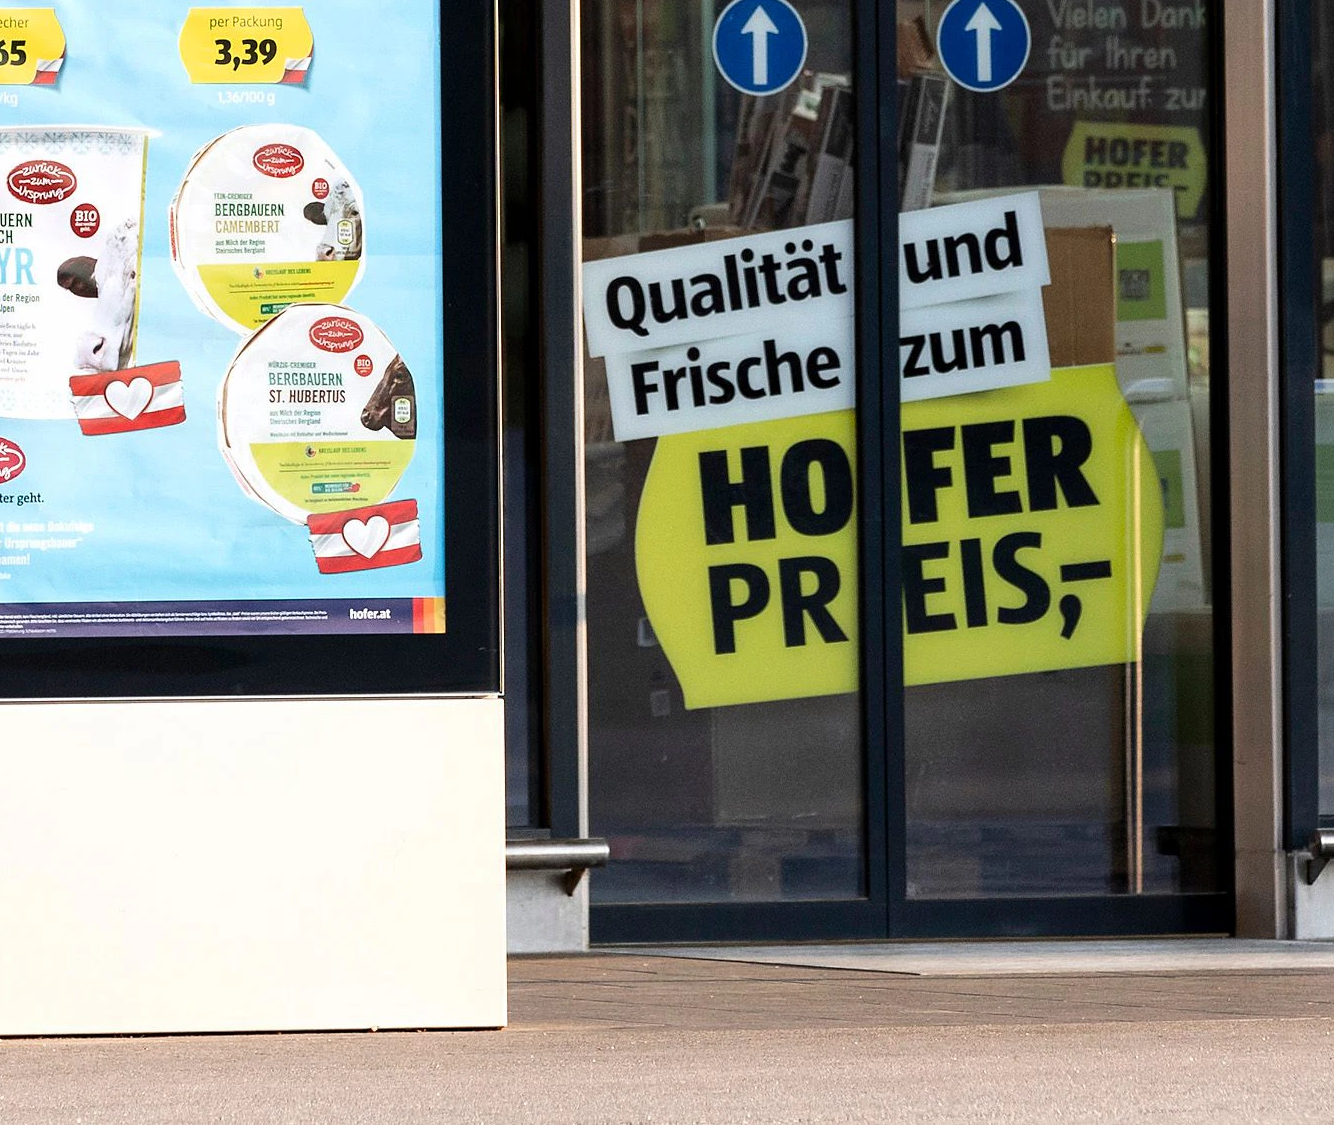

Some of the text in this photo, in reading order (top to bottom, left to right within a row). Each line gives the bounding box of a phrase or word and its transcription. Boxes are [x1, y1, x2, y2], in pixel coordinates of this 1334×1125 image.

[209, 15, 283, 31] per Packung
[214, 39, 278, 71] 3,39
[1047, 35, 1177, 70] für Ihren
[1046, 75, 1152, 111] Einkauf
[1085, 137, 1189, 169] HOFER
[22, 163, 61, 177] zurück
[30, 177, 51, 186] zum
[314, 182, 327, 190] BIO
[18, 186, 64, 203] Ursprung
[74, 210, 98, 222] BIO
[215, 203, 285, 217] BERGBAUERN
[215, 220, 280, 234] CAMEMBERT
[606, 211, 1023, 336] Qualität und
[2, 293, 13, 302] der
[15, 293, 40, 304] Region
[357, 359, 371, 367] BIO
[630, 319, 1027, 416] Frische zum
[269, 372, 343, 386] BERGBAUERN
[269, 389, 346, 404] ST. HUBERTUS
[698, 414, 1101, 546] HOFER
[17, 492, 45, 506] geht.
[349, 608, 391, 622] hofer.at
